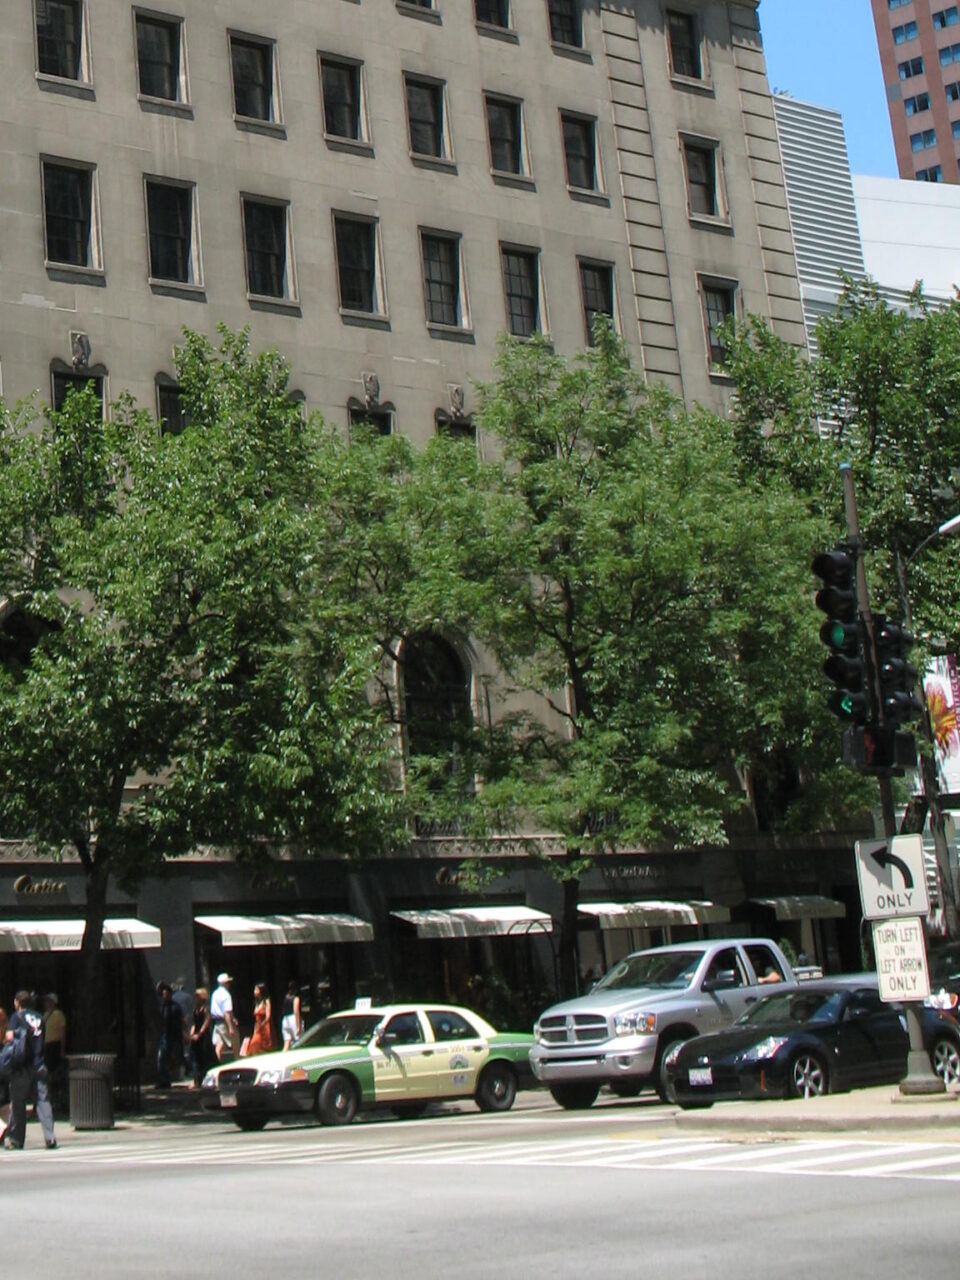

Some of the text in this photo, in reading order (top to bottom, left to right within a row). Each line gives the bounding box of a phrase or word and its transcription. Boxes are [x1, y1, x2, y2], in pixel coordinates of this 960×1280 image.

[14, 875, 67, 894] Cartier
[876, 892, 914, 910] ONLY
[877, 927, 919, 943] TURN LEFT
[894, 947, 906, 957] ON
[880, 958, 922, 974] LEFT ARROW
[889, 977, 918, 991] ONLY
